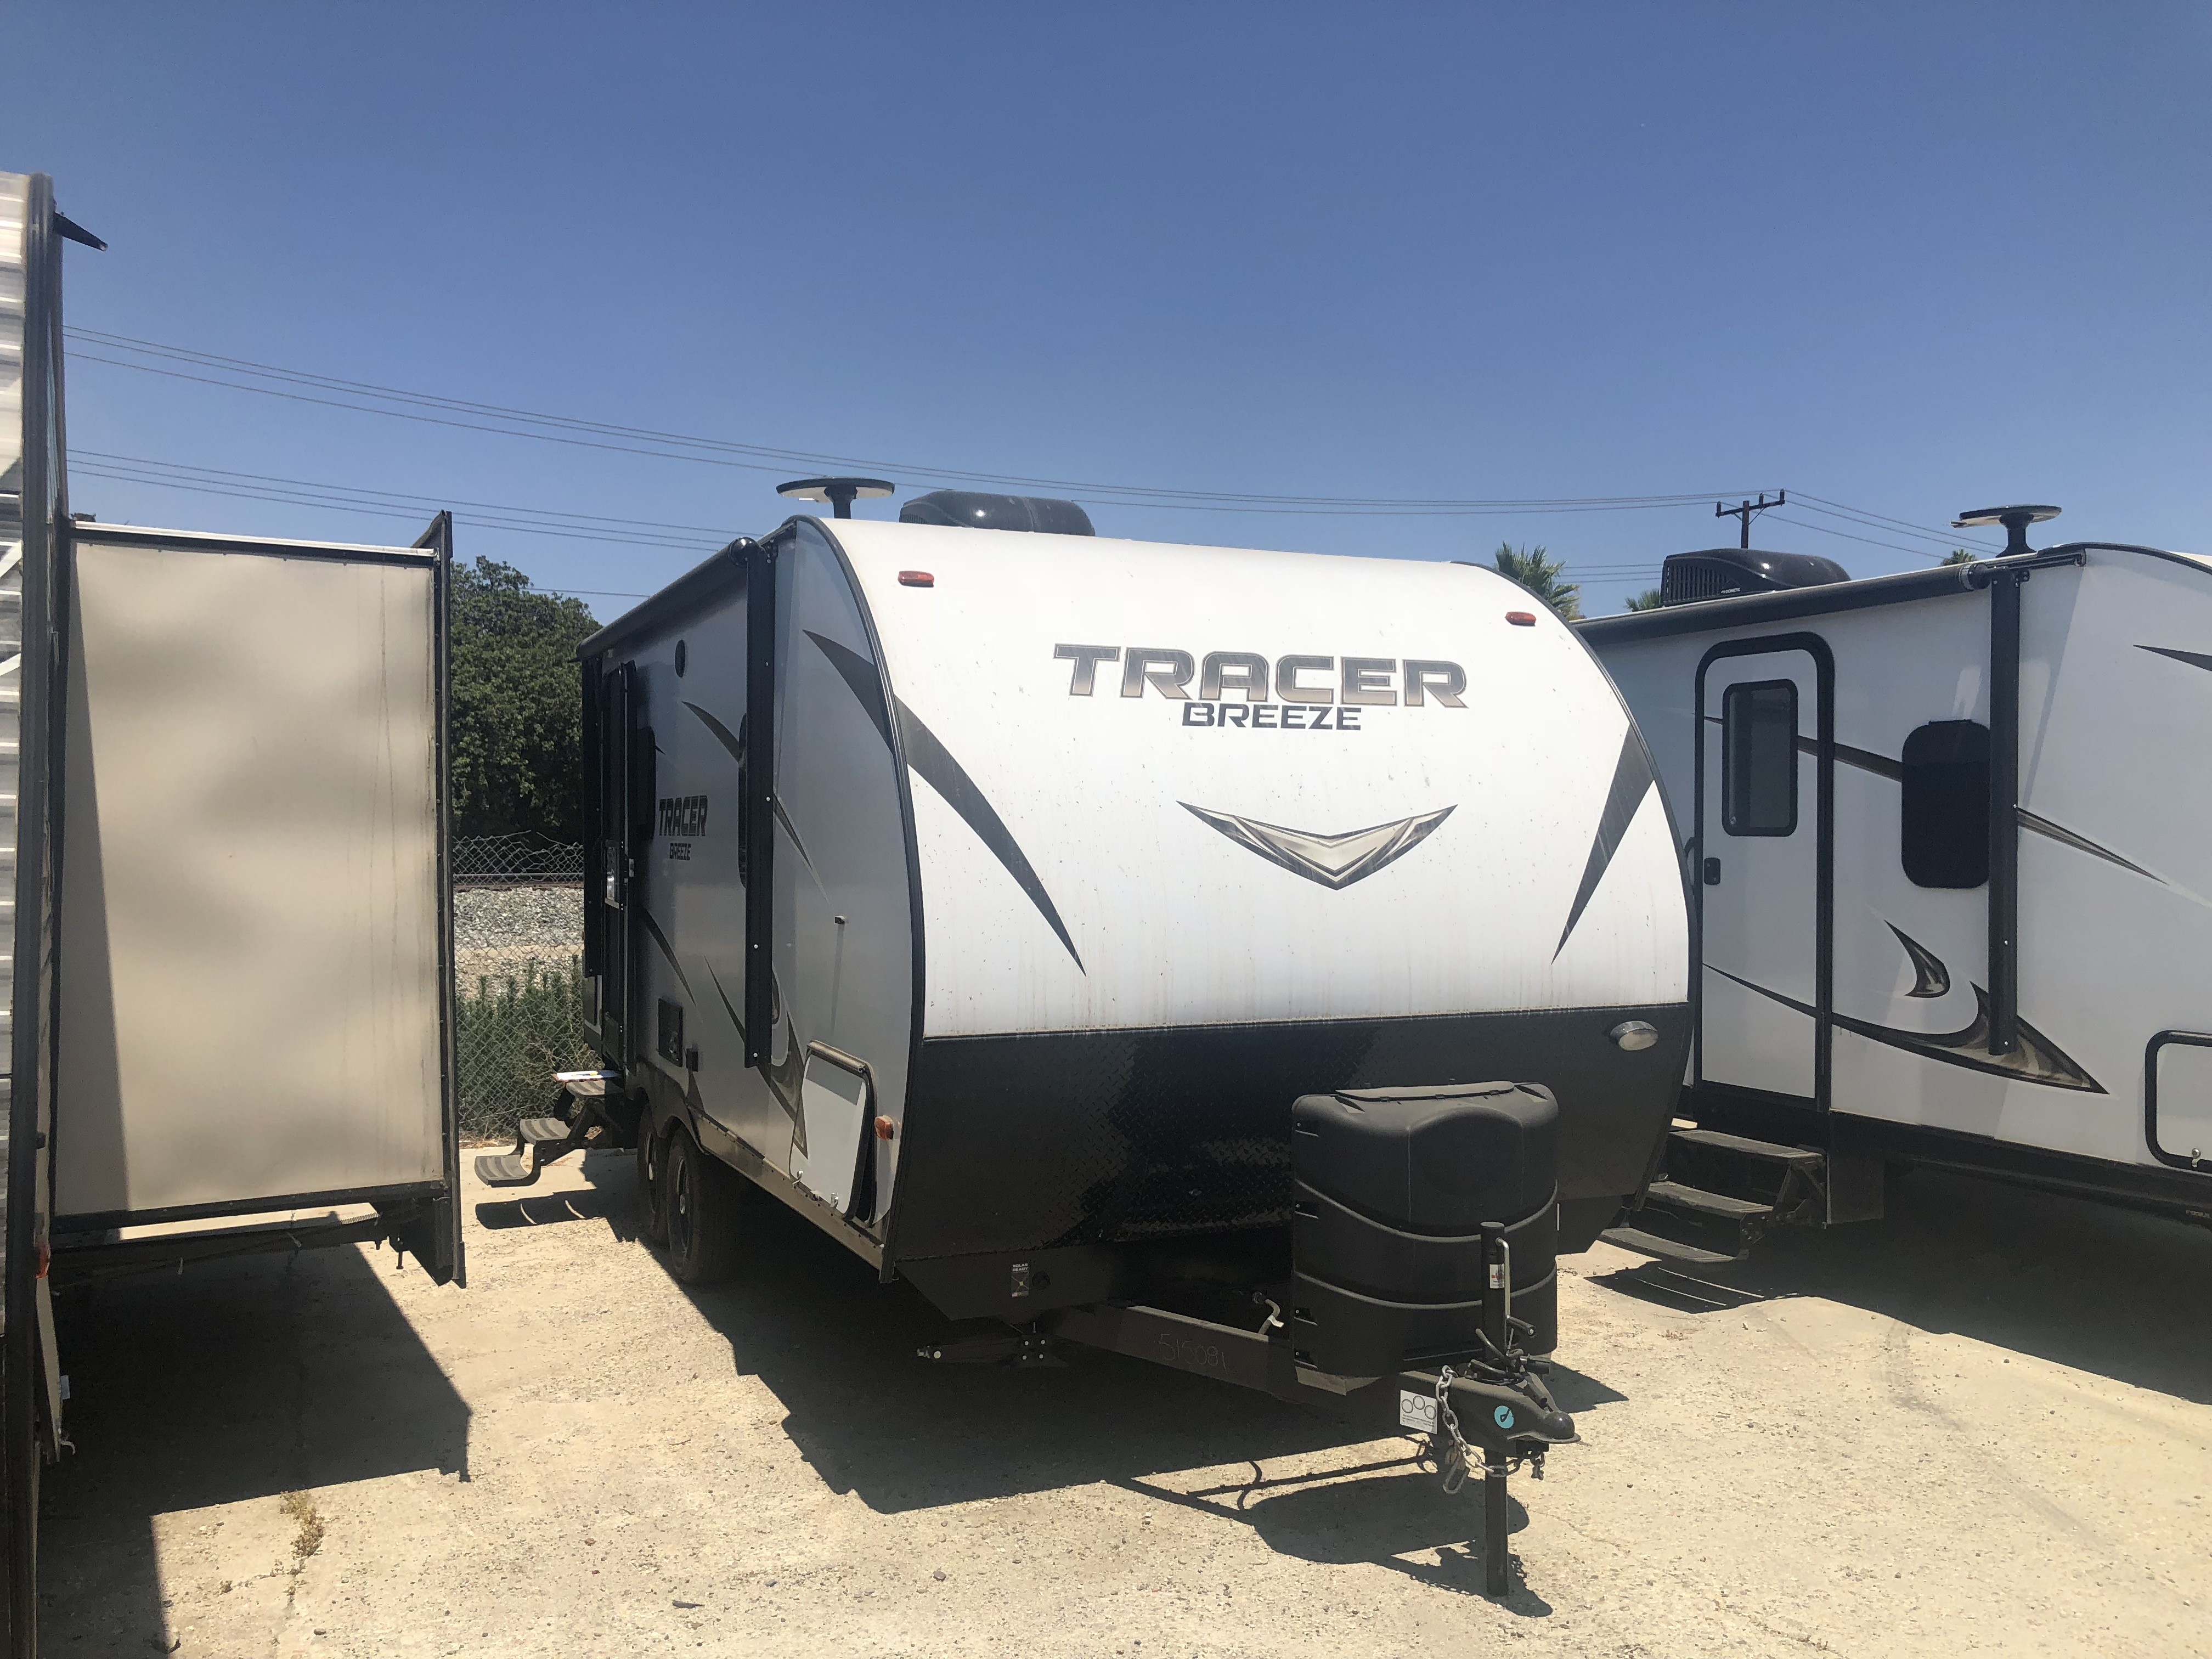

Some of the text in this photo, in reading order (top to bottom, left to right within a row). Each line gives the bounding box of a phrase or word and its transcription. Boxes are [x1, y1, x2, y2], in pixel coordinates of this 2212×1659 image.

[1053, 643, 1469, 709] TRACER
[1182, 701, 1362, 731] BREEZE
[659, 795, 708, 836] TRACER
